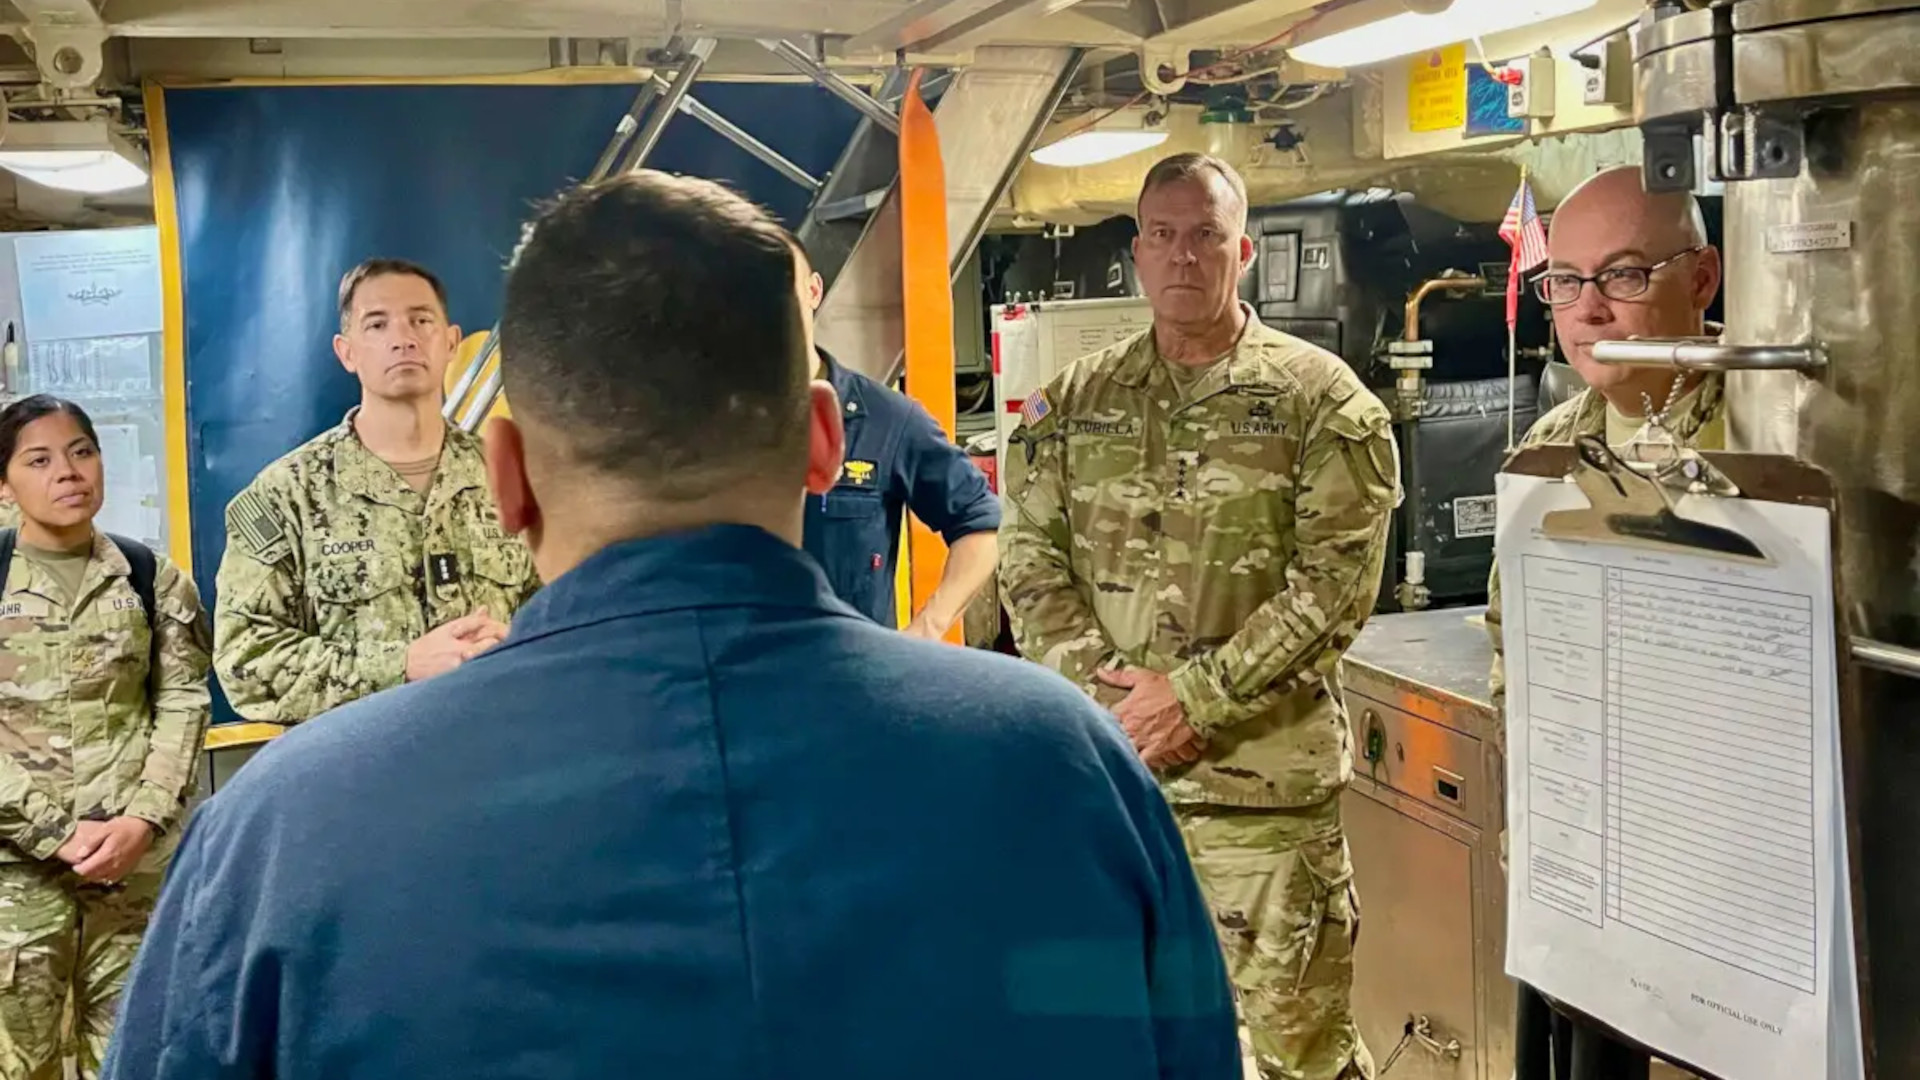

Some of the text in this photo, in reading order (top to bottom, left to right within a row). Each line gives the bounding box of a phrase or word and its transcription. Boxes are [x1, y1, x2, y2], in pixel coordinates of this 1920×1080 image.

[1253, 420, 1289, 436] ARMY
[321, 539, 375, 556] COOPER
[1690, 993, 1783, 1037] FOR OFFICIAL USE ONLY
